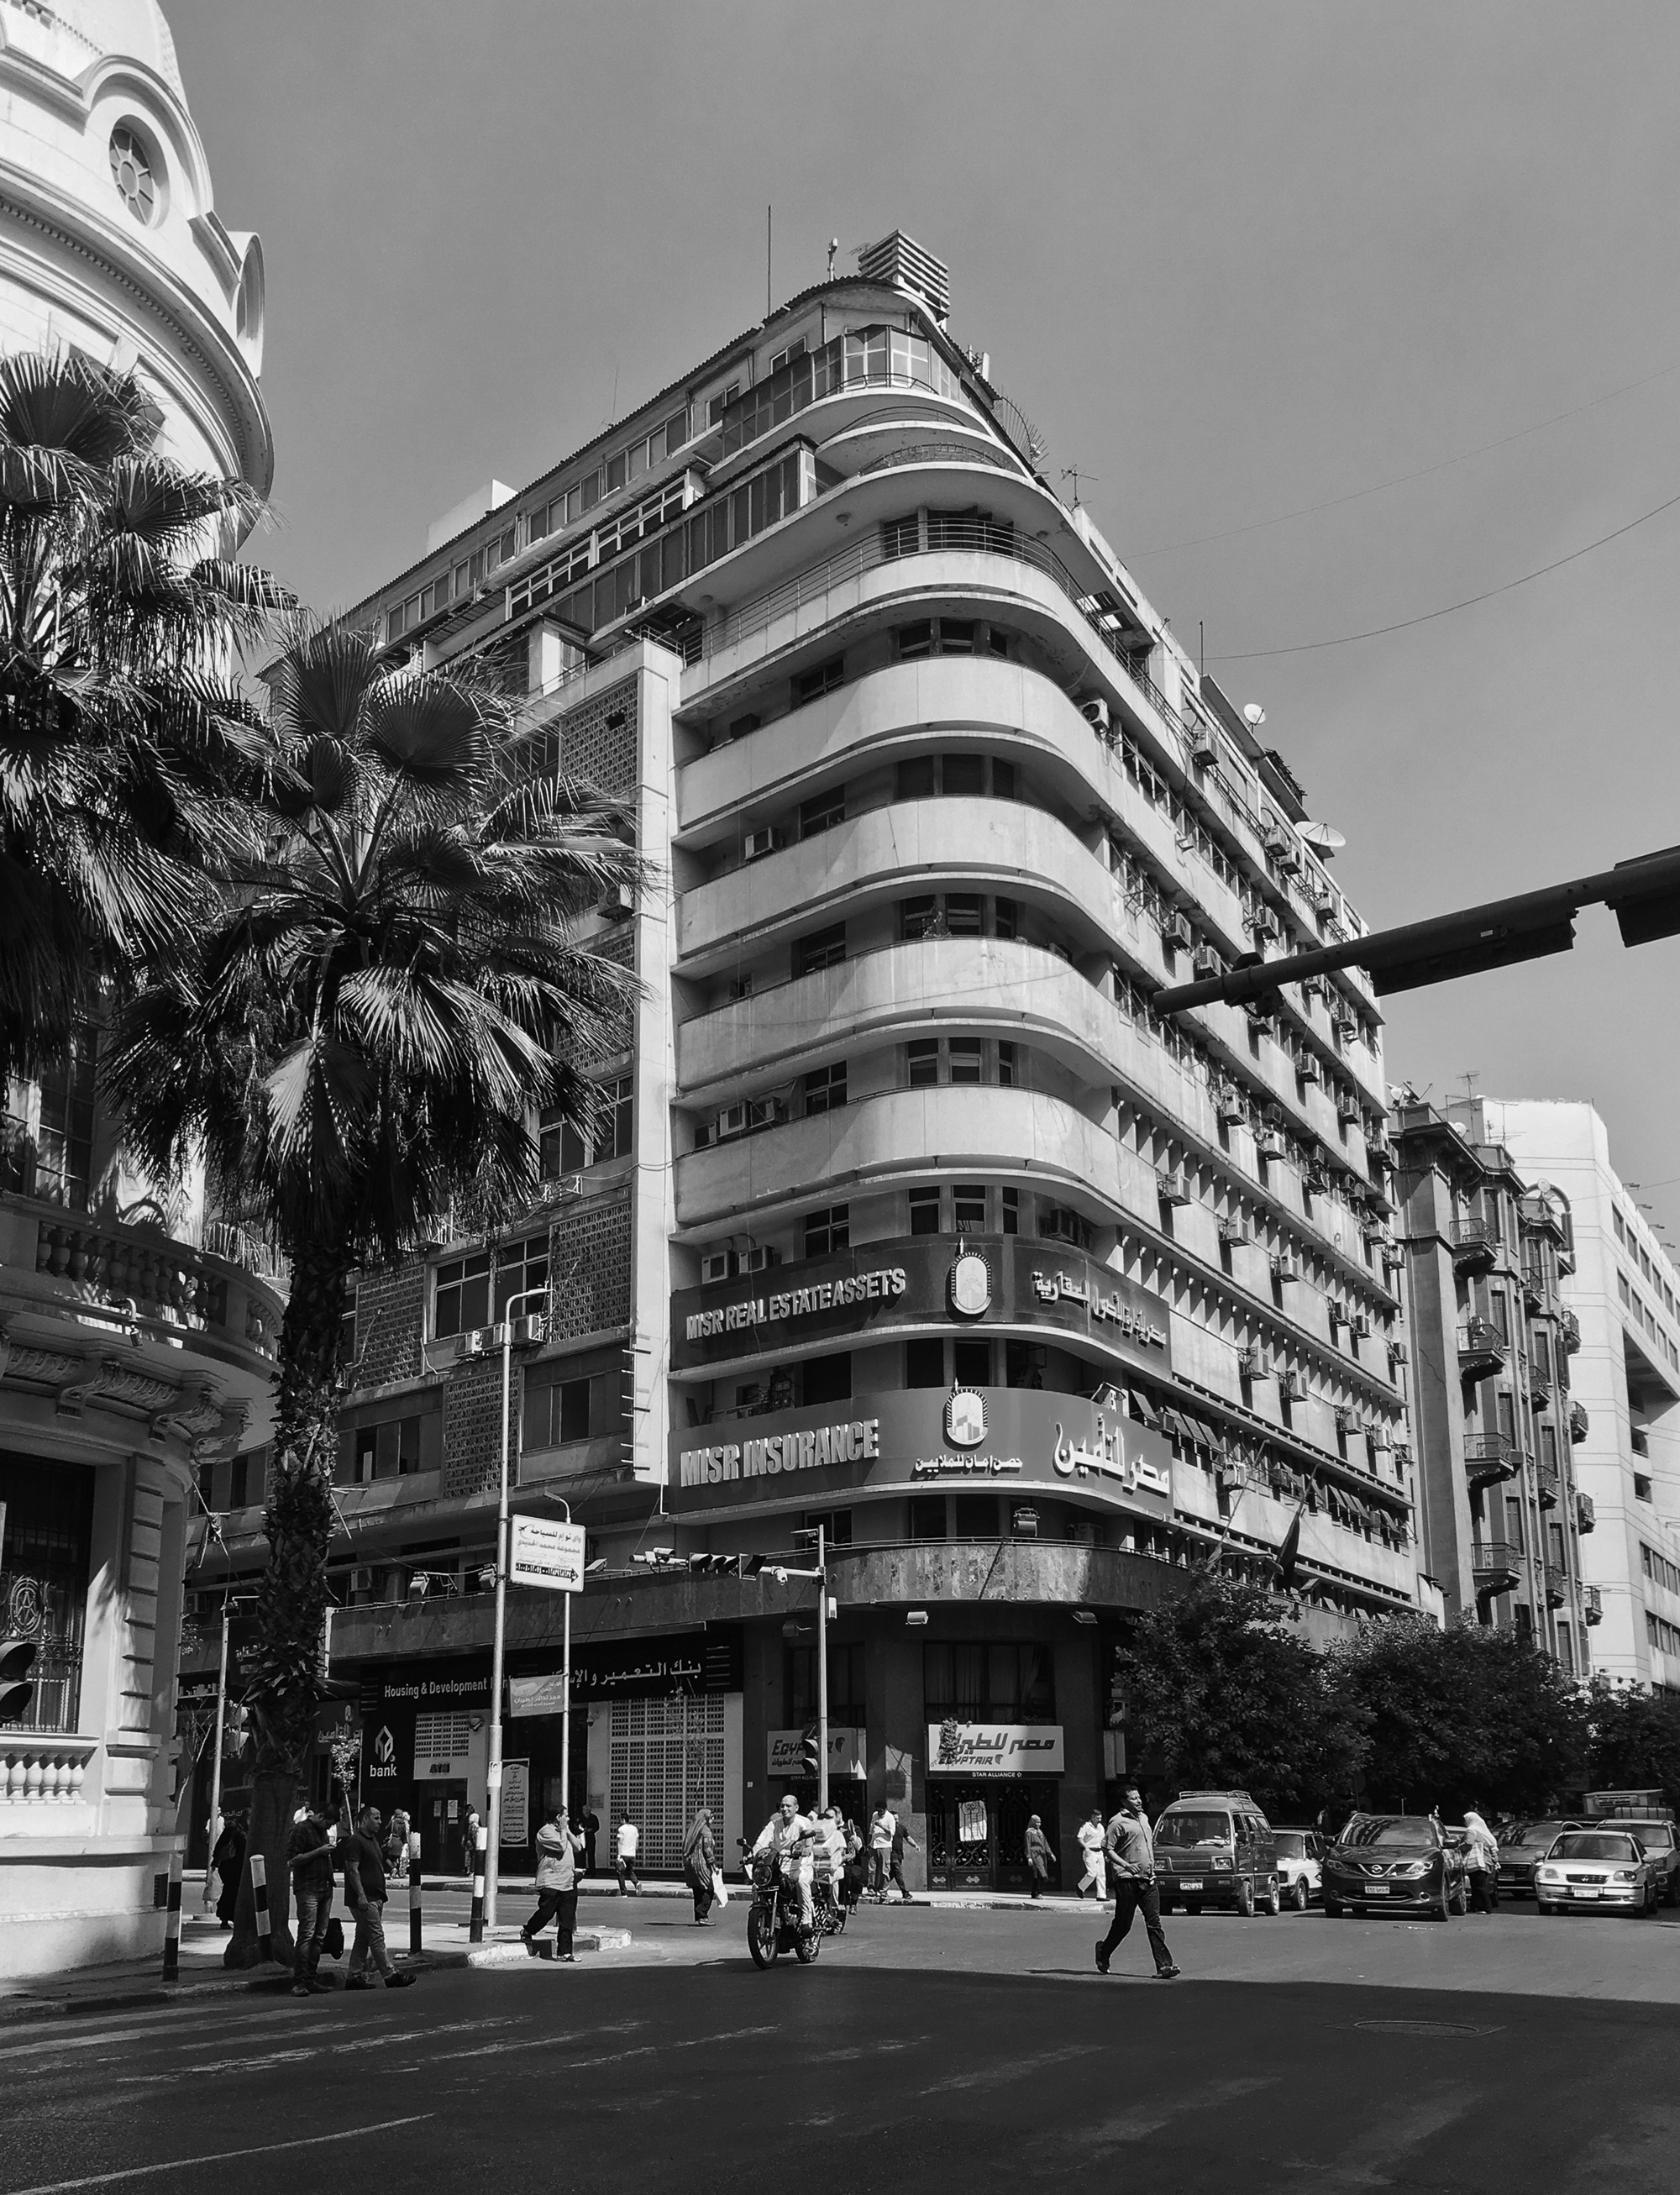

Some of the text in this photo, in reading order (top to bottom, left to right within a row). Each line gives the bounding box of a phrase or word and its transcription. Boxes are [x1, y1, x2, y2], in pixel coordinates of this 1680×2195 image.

[1032, 1270, 1090, 1303] العقارية
[686, 1268, 906, 1340] MISR REAL ESTATE ASSETS
[1137, 1323, 1167, 1345] مصر
[680, 1418, 879, 1487] MISR INSURANCE
[1053, 1412, 1170, 1494] مصر للتأمين
[915, 1454, 964, 1473] للملايين
[993, 1457, 1023, 1471] حصن
[531, 1525, 558, 1538] للسياحة
[601, 1662, 666, 1686] التعمير
[669, 1659, 701, 1679] بنك
[385, 1683, 419, 1699] Housing
[421, 1682, 428, 1694] &
[429, 1678, 487, 1696] Development
[1008, 1740, 1056, 1755] مصر
[370, 1764, 397, 1778] bank
